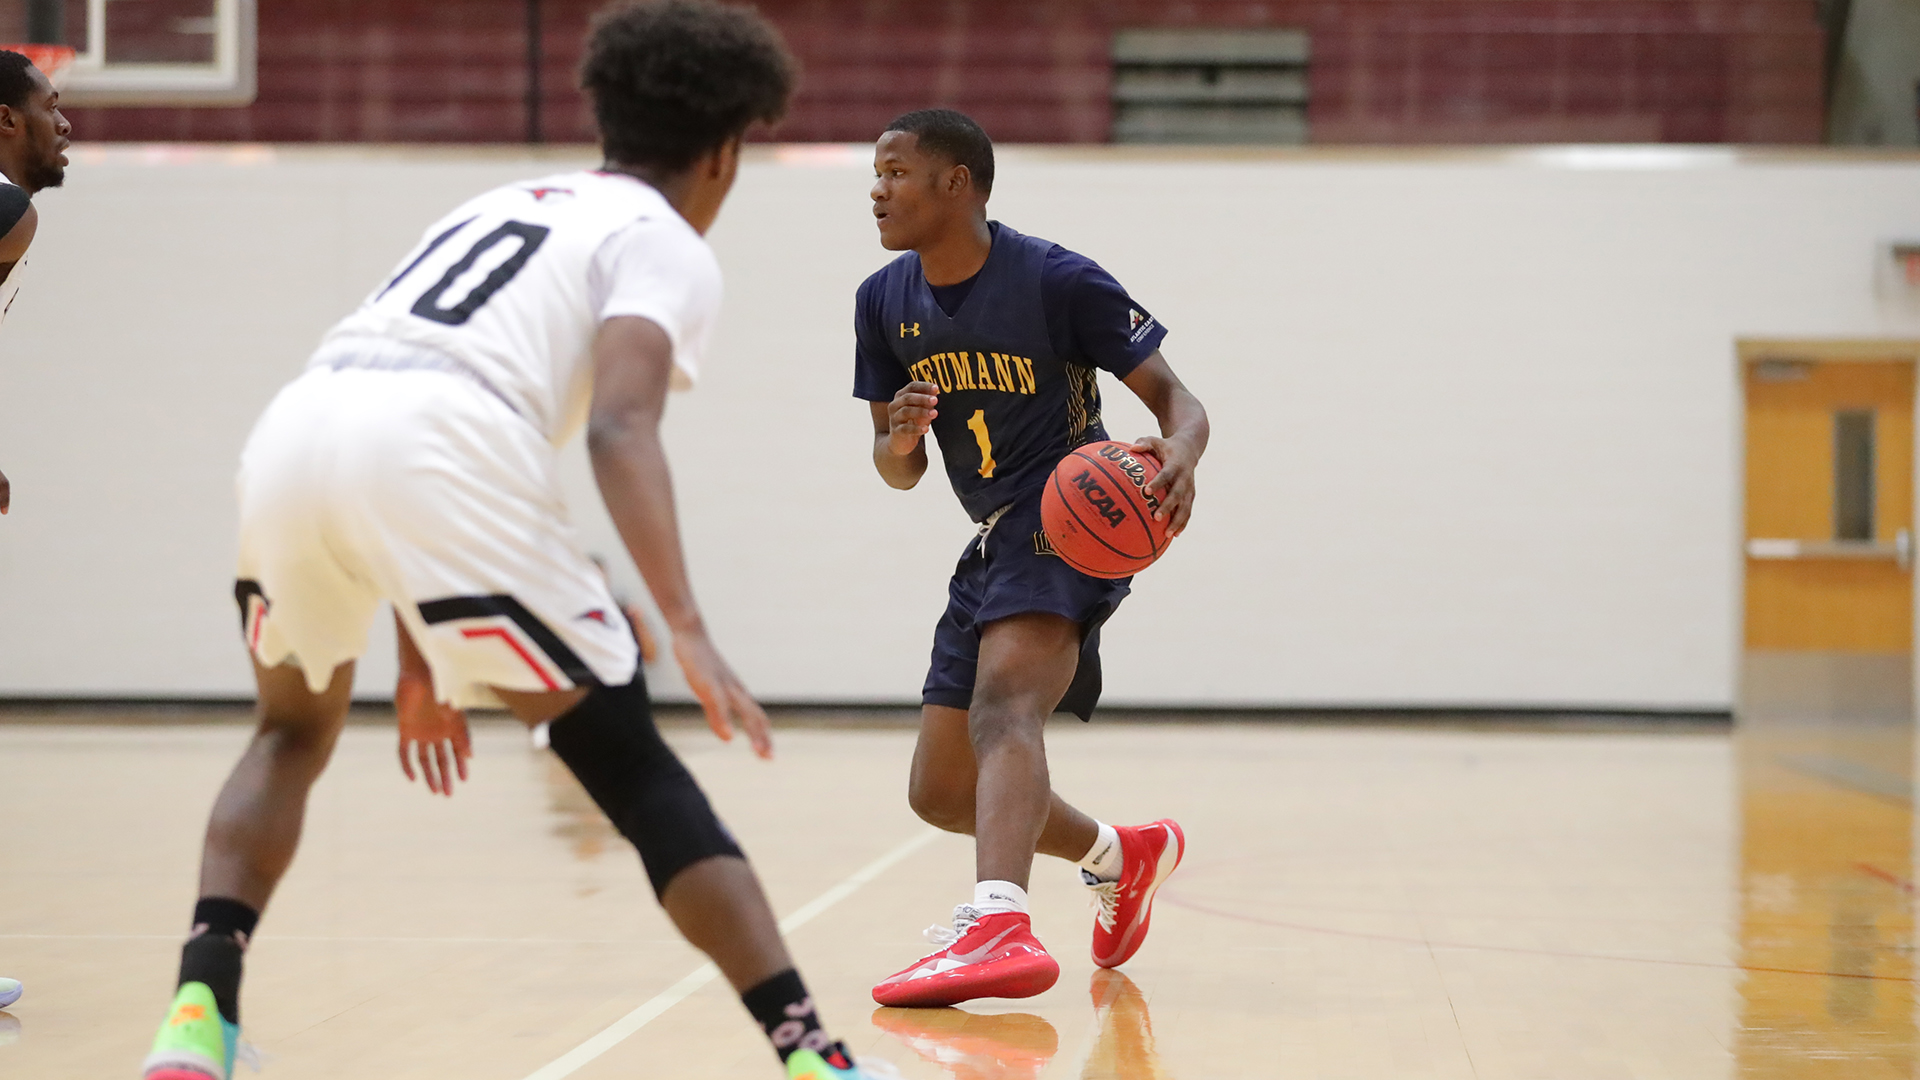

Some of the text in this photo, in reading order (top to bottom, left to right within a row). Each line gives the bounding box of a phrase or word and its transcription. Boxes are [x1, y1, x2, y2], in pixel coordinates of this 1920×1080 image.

[1130, 324, 1146, 343] ATLANTIC
[967, 409, 997, 478] 1
[1071, 469, 1127, 529] NCAA
